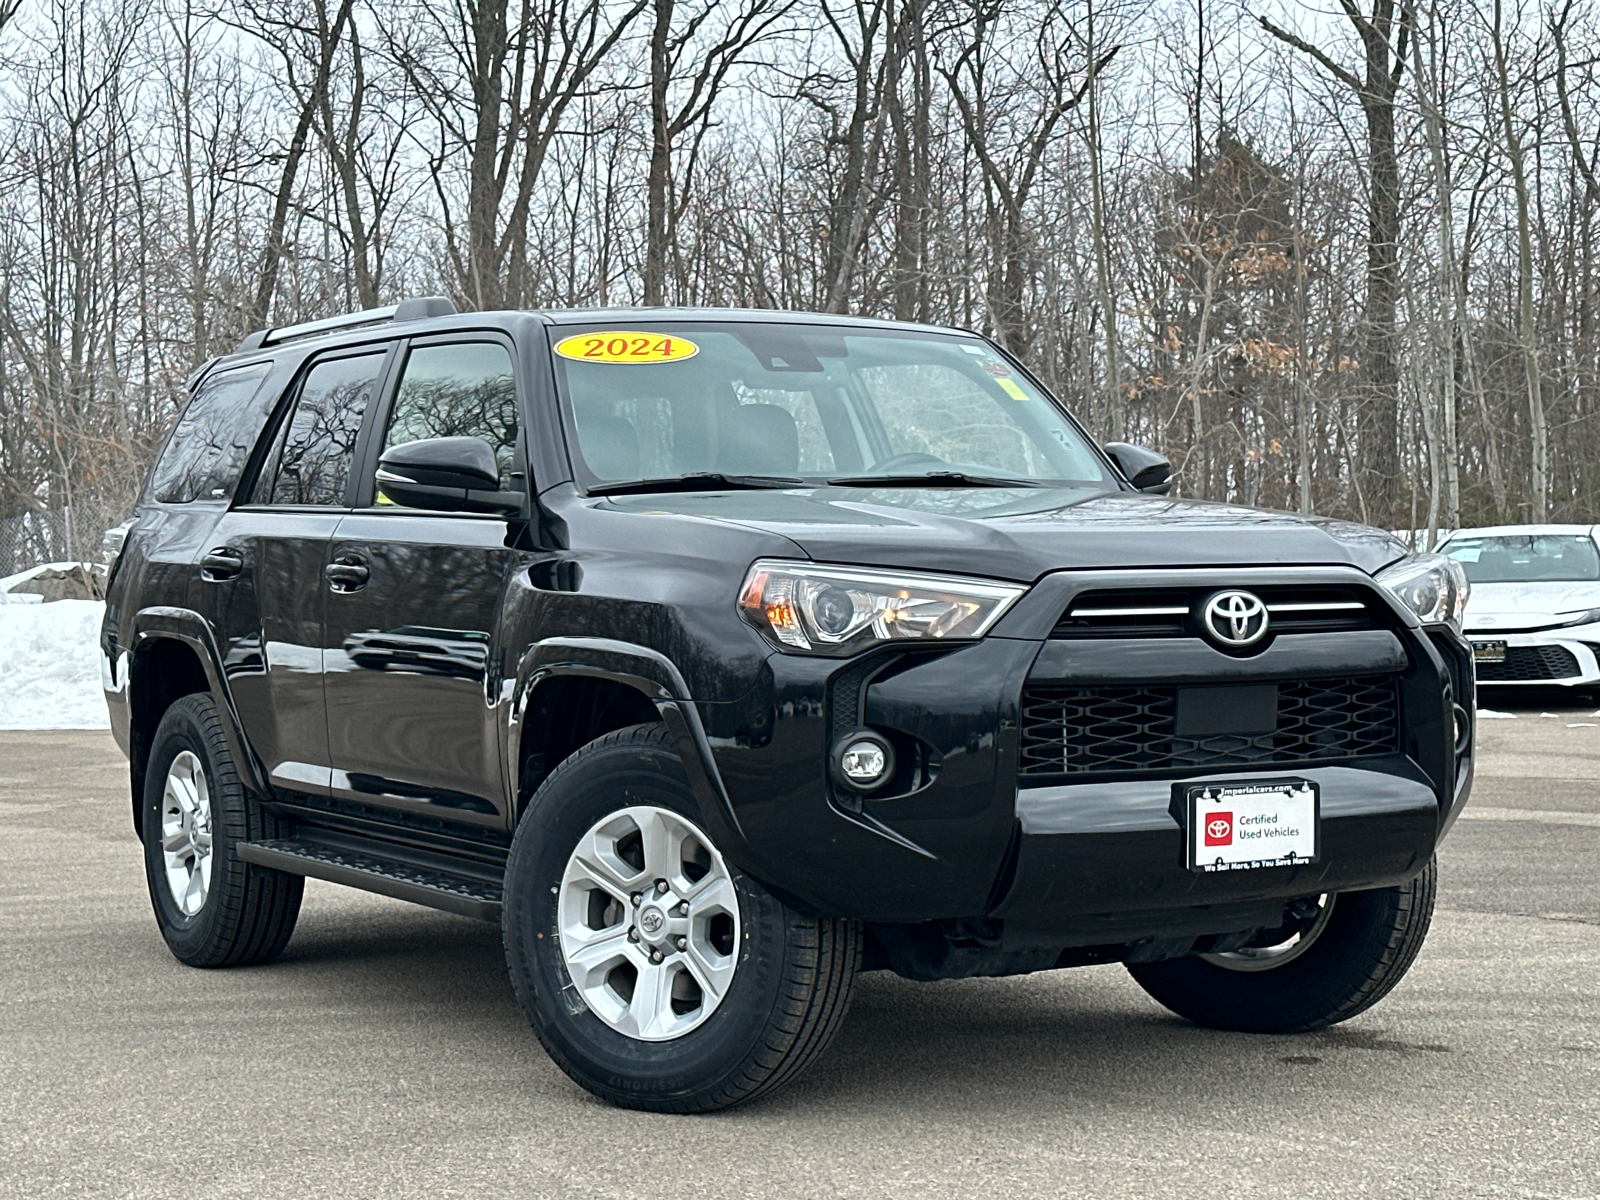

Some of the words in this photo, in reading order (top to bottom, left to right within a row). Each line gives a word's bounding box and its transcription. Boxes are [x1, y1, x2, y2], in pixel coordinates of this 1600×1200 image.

[584, 338, 675, 357] 2024
[1220, 785, 1292, 797] Imperialcars.com
[1239, 813, 1278, 825] Certified
[1239, 828, 1262, 839] Used
[1263, 826, 1300, 838] Vehicles
[1204, 864, 1216, 872] We
[1216, 863, 1230, 871] Sell
[1251, 860, 1260, 868] So
[1275, 858, 1291, 866] Save
[1292, 857, 1309, 865] More
